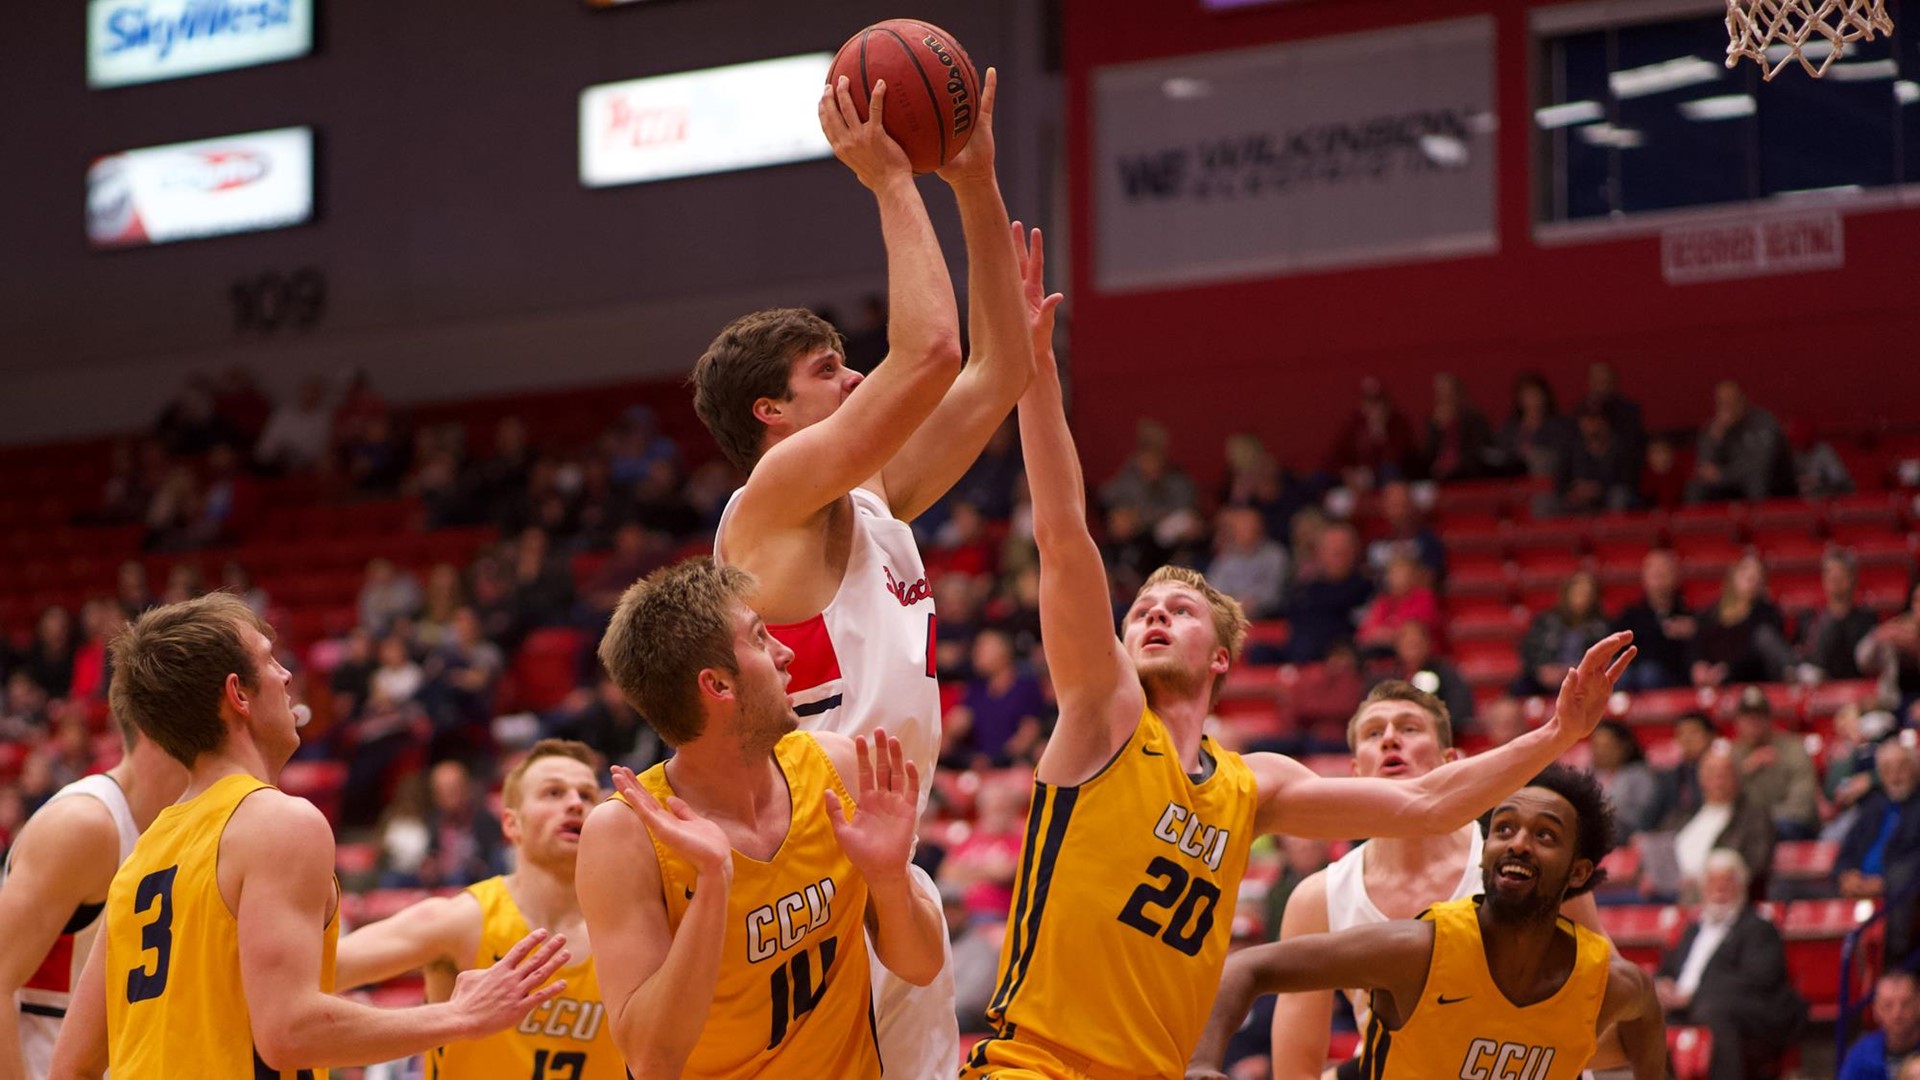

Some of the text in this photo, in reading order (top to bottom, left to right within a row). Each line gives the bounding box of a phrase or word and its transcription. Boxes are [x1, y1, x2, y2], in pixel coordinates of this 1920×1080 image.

[922, 34, 971, 138] Wilson
[1153, 800, 1230, 872] CCU
[127, 865, 178, 1003] 3
[746, 877, 836, 964] CCU
[1117, 856, 1221, 957] 20
[517, 996, 605, 1041] CCU
[1459, 1037, 1556, 1080] CCU
